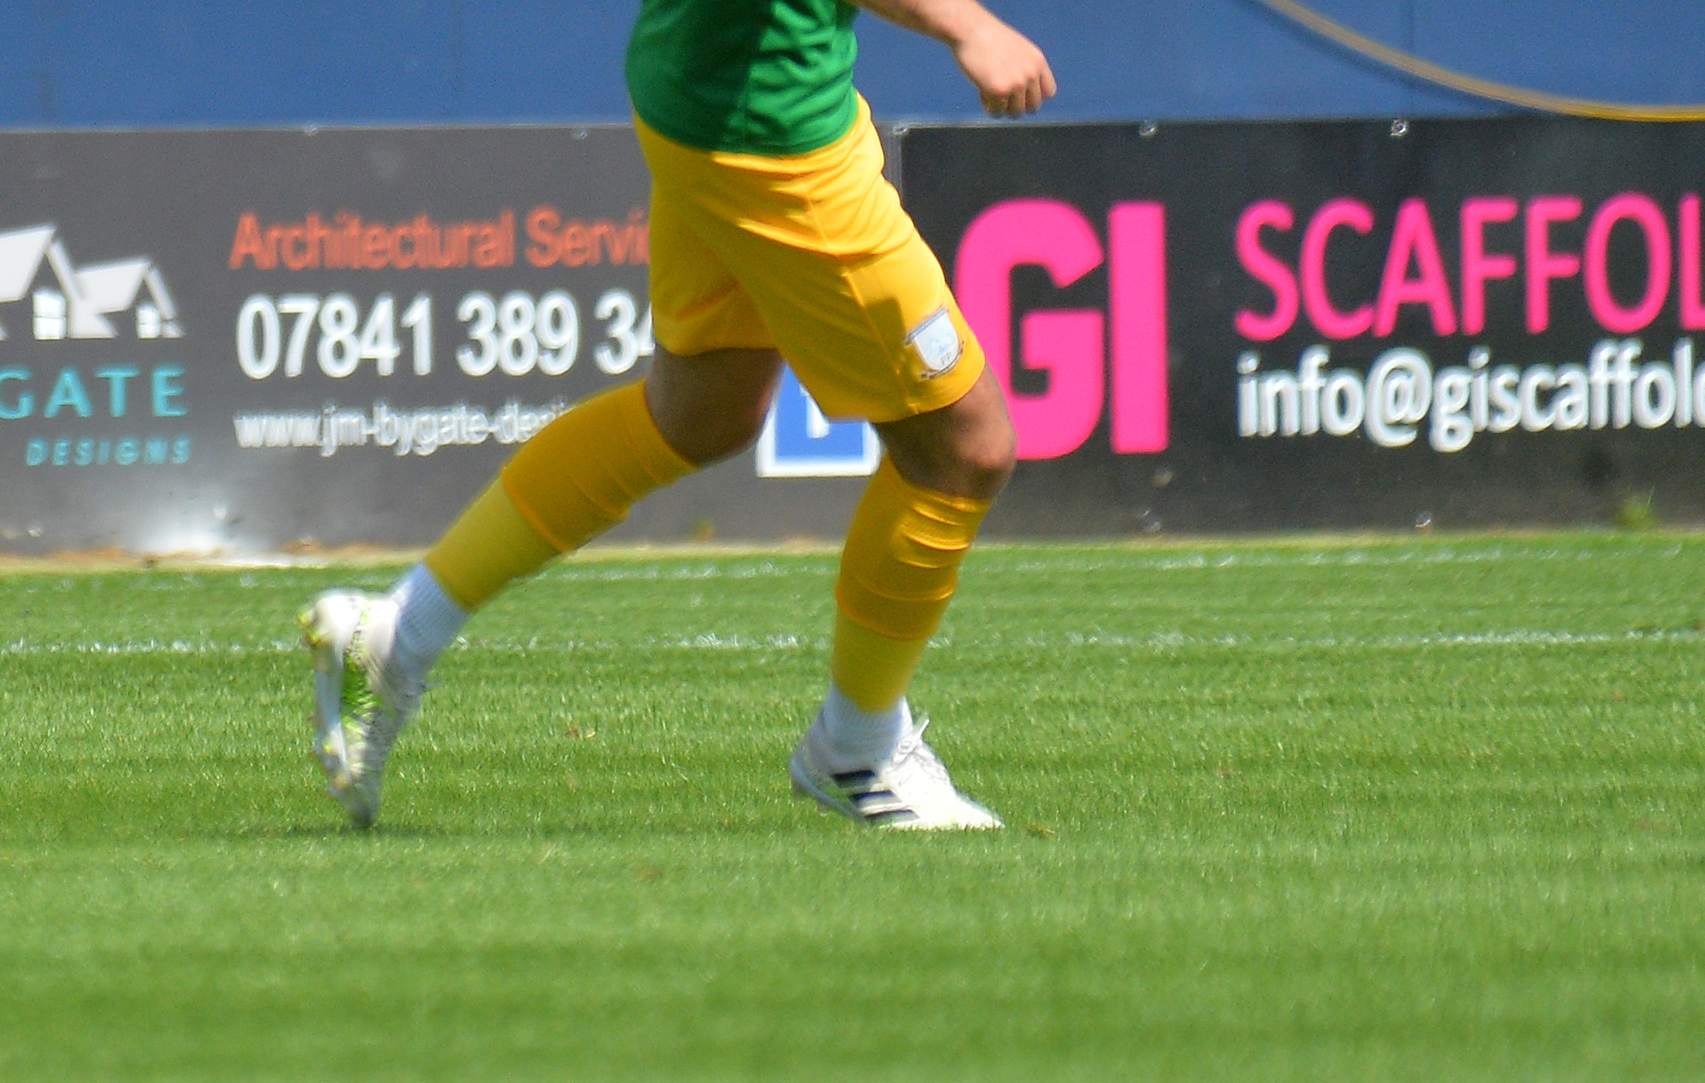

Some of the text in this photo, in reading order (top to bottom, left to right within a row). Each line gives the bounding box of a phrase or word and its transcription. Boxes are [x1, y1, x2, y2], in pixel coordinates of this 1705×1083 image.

[229, 206, 651, 270] Architectural Servi
[1235, 192, 1705, 341] SCAFFOL
[236, 291, 432, 379] 07841
[457, 290, 579, 377] 389
[953, 197, 1168, 461] GI
[25, 436, 192, 467] DESIGNS
